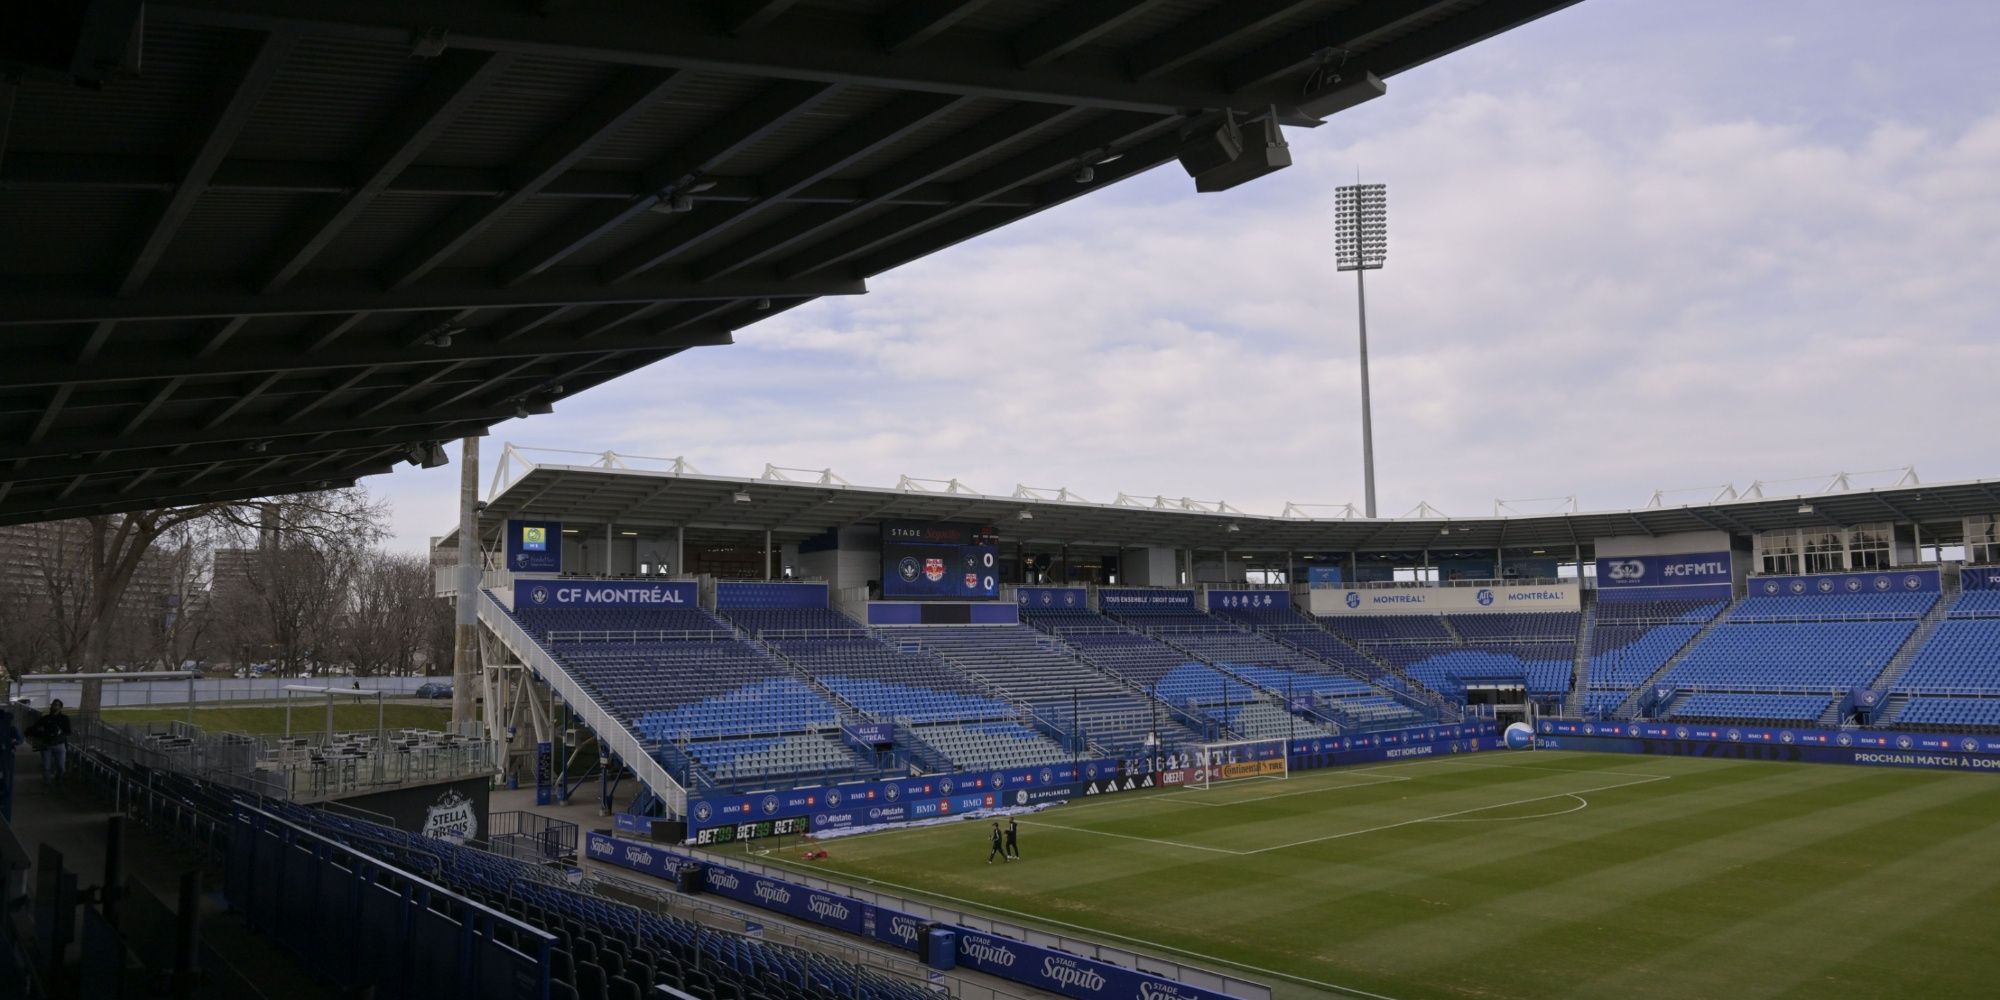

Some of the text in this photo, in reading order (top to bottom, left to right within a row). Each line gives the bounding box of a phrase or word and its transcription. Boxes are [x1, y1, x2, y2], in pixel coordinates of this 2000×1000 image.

[892, 528, 920, 536] STADE
[984, 553, 994, 568] 0
[1664, 562, 1726, 576] #CFMTL
[984, 576, 994, 590] 0
[556, 586, 683, 603] CF MONTRÉAL
[1386, 748, 1400, 758] NEXT
[1418, 746, 1432, 754] GAME
[1855, 753, 1914, 764] PROCHAIN
[1917, 756, 1958, 766] MATCH
[1961, 756, 1970, 766] À
[1224, 762, 1262, 778] Continental
[1039, 789, 1070, 798] APPLIANCES
[916, 804, 936, 814] BMO
[963, 799, 982, 808] BMO
[432, 810, 468, 826] STELLA
[827, 814, 852, 823] Allstate
[881, 808, 904, 817] Allstate
[698, 826, 732, 844] BET99
[737, 822, 770, 840] BET99
[664, 856, 680, 876] Sap
[706, 867, 739, 890] Saputo
[754, 880, 791, 904] Saputo
[808, 894, 849, 920] Saputo
[901, 917, 916, 926] STADE
[890, 916, 918, 944] Sap
[973, 936, 990, 946] STADE
[960, 936, 1016, 966] Saputo
[1056, 957, 1078, 968] STADE
[1041, 956, 1106, 992] Saputo
[1154, 983, 1178, 994] STADE
